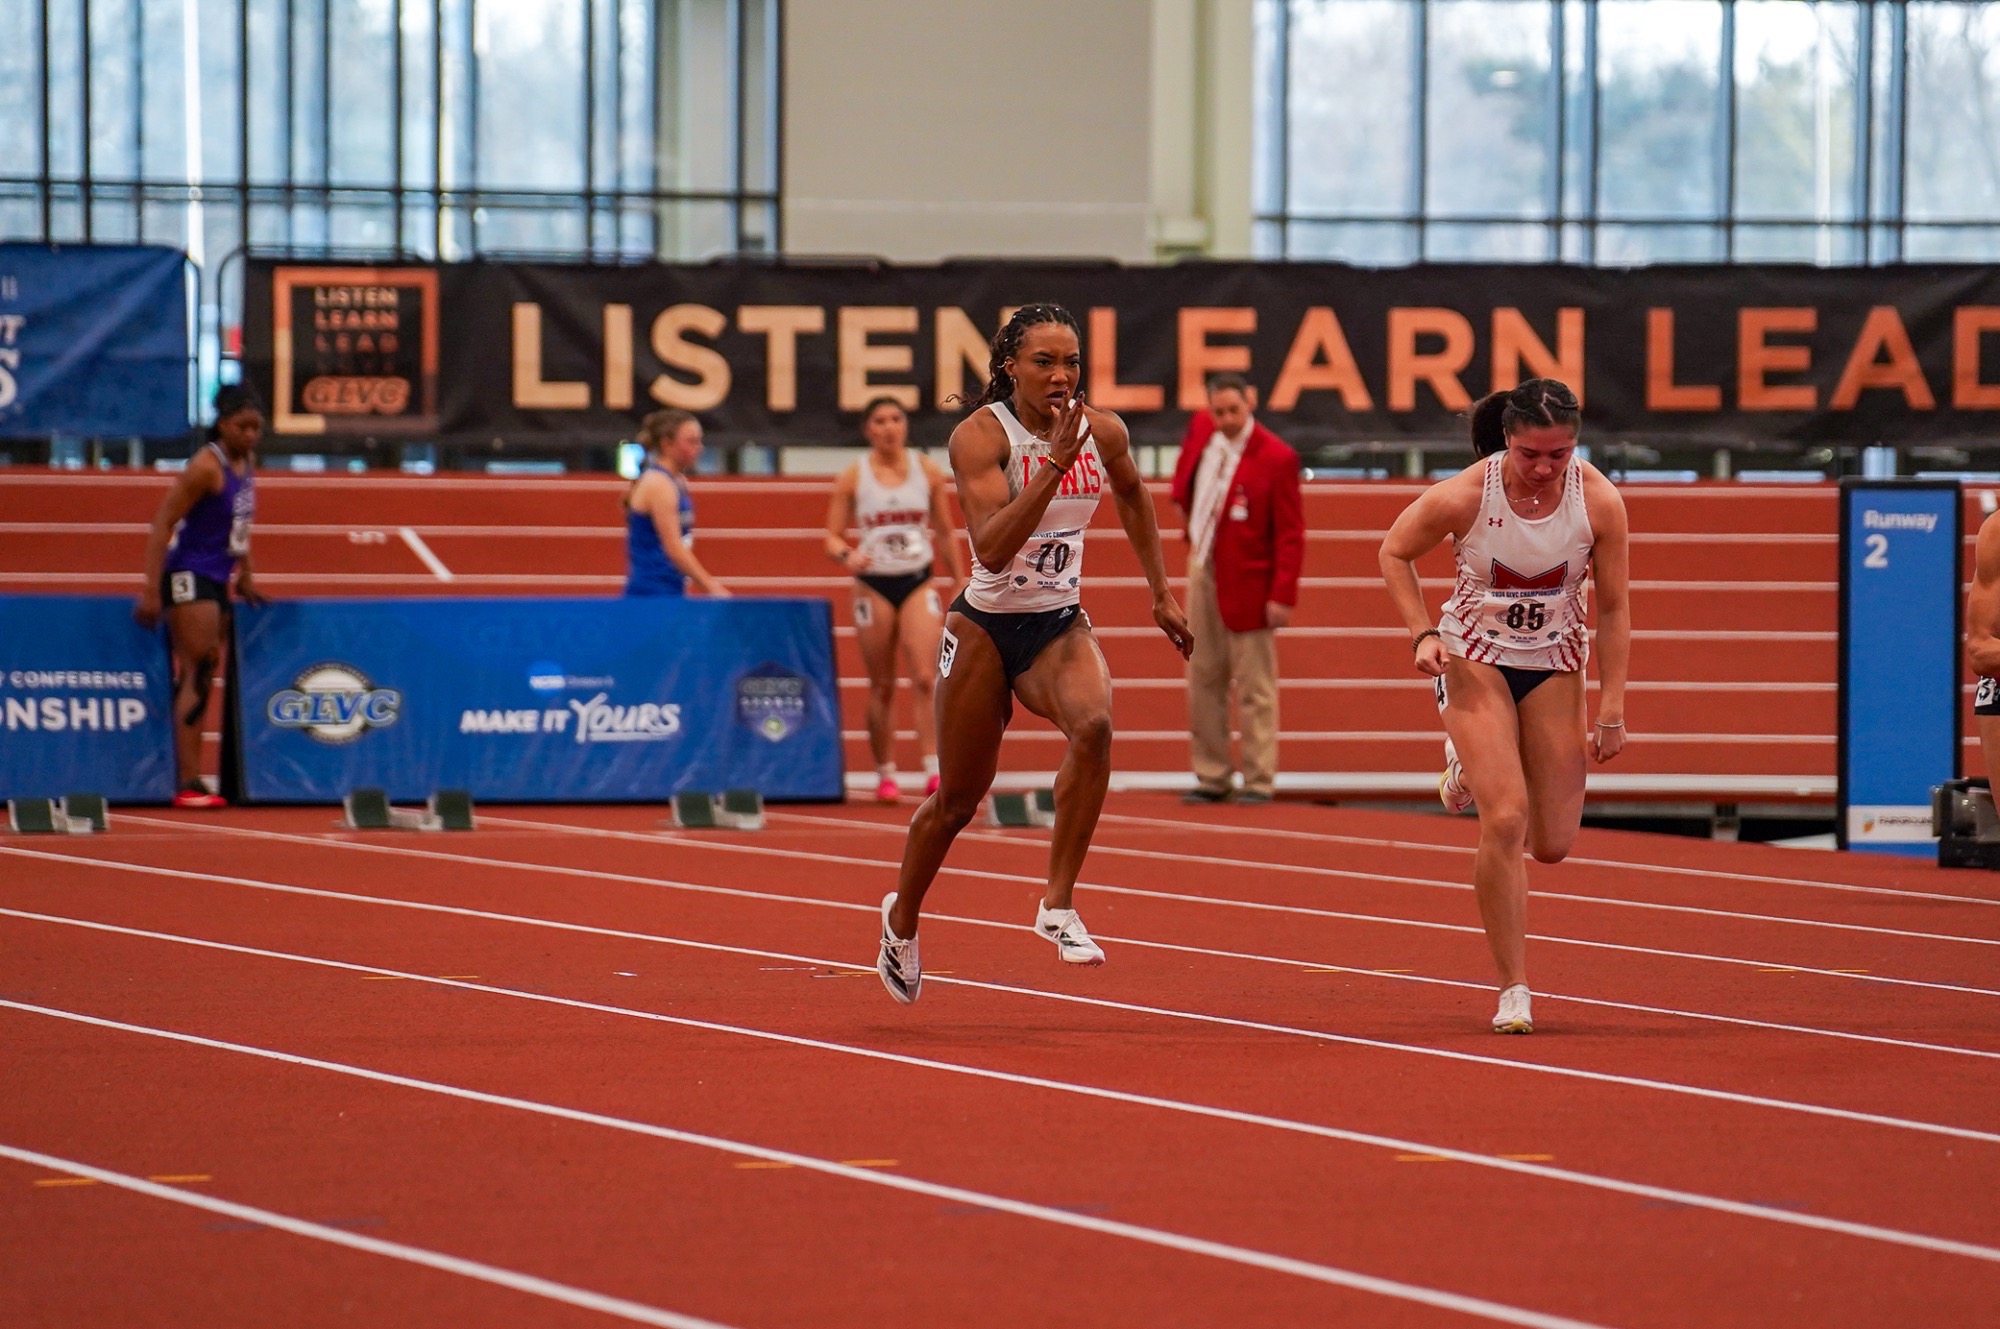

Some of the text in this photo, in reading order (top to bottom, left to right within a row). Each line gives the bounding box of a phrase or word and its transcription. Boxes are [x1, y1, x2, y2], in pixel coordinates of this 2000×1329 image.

[314, 287, 399, 307] LISTEN
[314, 309, 399, 330] LEARN
[1087, 304, 1586, 412] LEARN
[1022, 452, 1101, 496] LWIS
[1863, 509, 1938, 533] Runway
[1036, 543, 1070, 573] 70
[1863, 534, 1889, 568] 2
[1507, 602, 1545, 630] 85
[10, 670, 146, 689] CONFERENCE
[0, 696, 147, 732] NSHIP
[268, 689, 401, 727] GLVC
[460, 709, 540, 733] MAKE
[543, 709, 571, 733] IT
